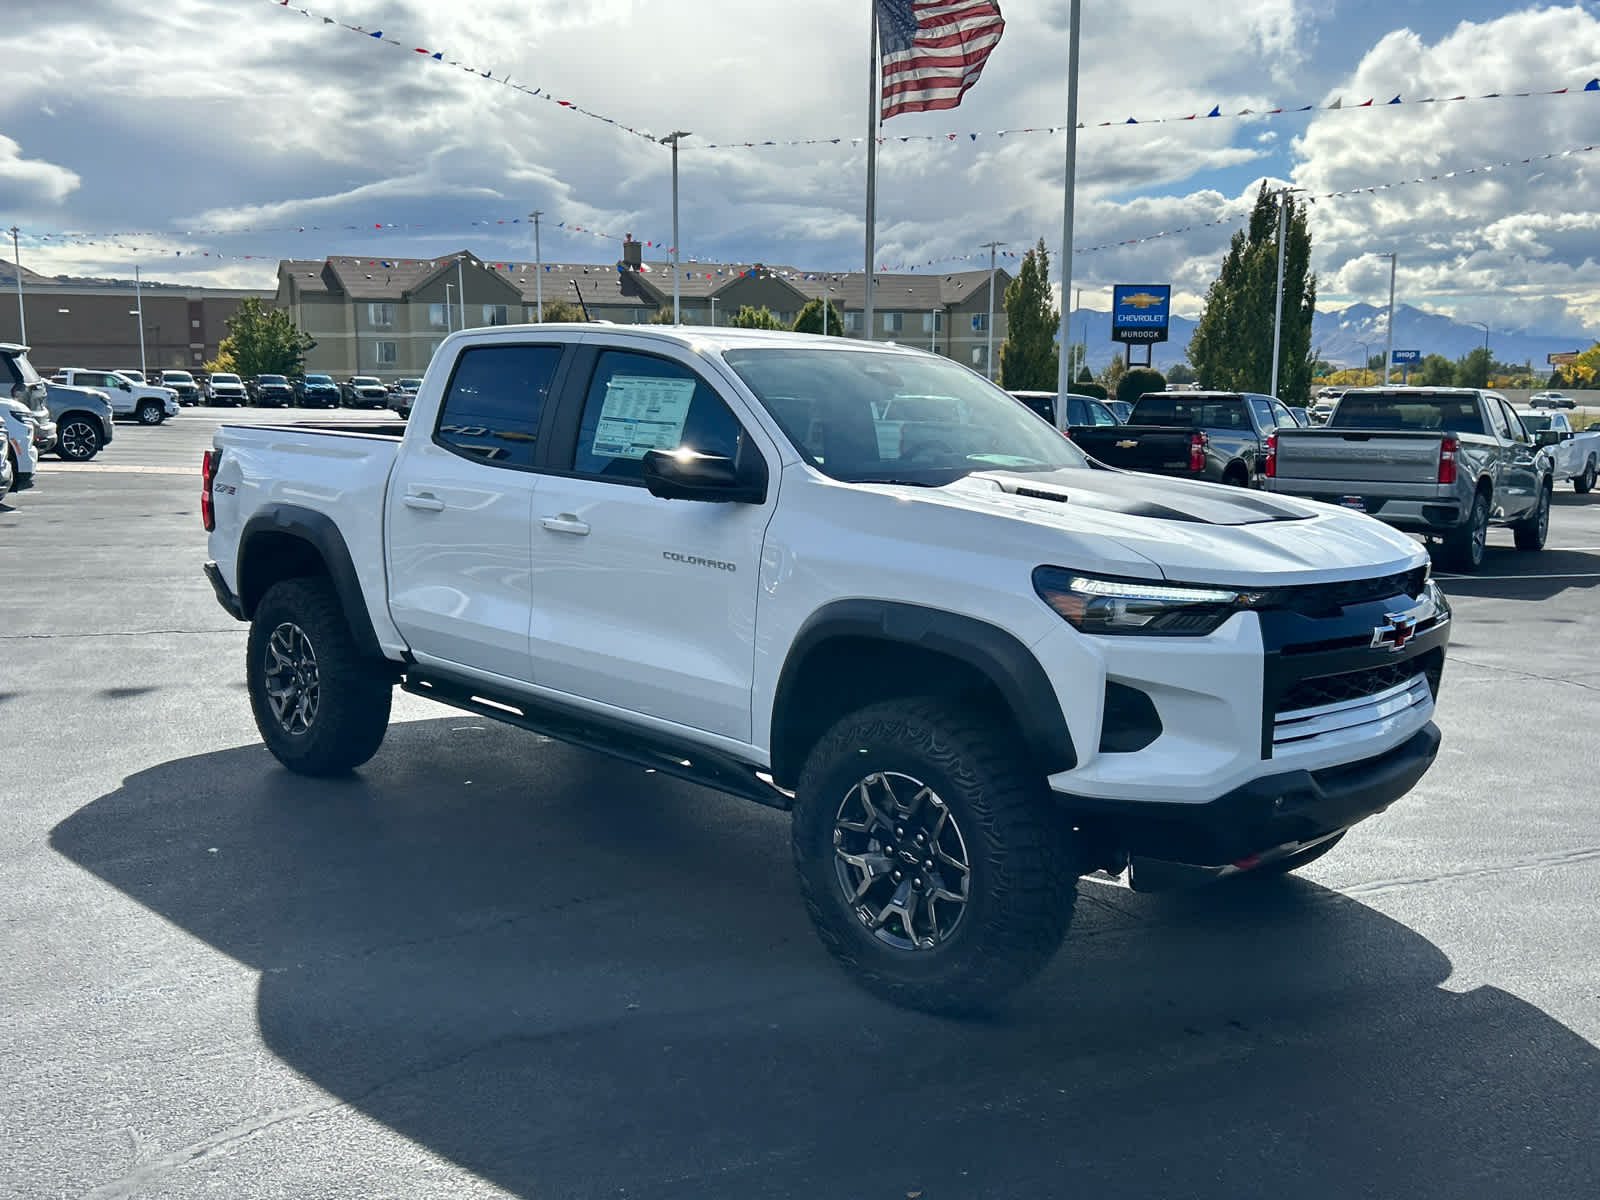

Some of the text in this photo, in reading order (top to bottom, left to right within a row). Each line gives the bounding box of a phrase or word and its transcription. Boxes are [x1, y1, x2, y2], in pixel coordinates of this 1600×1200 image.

[1117, 314, 1164, 322] CHEVROLET
[1120, 330, 1160, 338] MURDOCK
[662, 551, 737, 572] COLORADO
